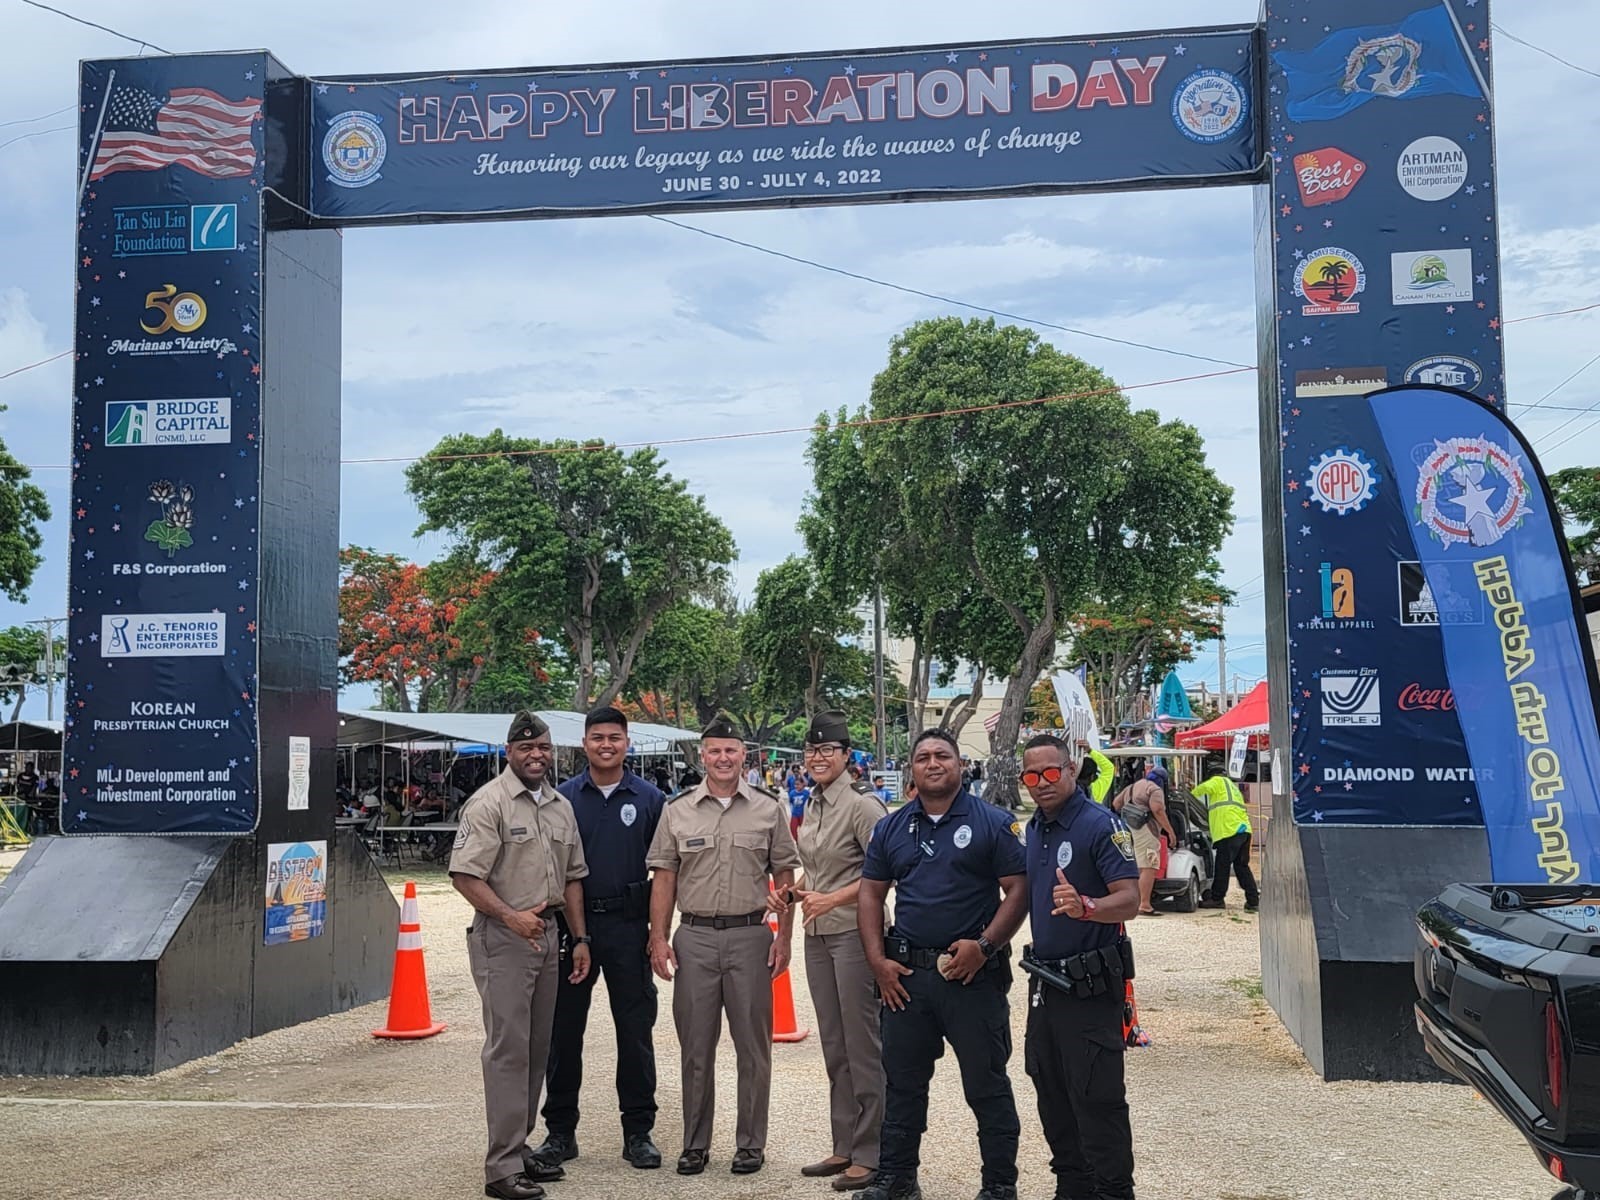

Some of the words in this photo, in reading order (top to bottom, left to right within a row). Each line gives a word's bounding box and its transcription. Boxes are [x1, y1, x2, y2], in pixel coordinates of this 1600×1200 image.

[399, 87, 616, 145] HAPPY
[633, 66, 1011, 135] LIBERATION
[1031, 55, 1167, 112] DAY
[473, 150, 582, 178] Honoring
[589, 150, 630, 170] our
[635, 145, 710, 174] legacy
[718, 147, 744, 163] as
[752, 146, 784, 162] we
[790, 138, 837, 160] ride
[842, 136, 878, 157] the
[883, 137, 955, 155] waves
[964, 128, 990, 157] of
[997, 126, 1082, 156] change
[1402, 151, 1463, 166] ARTMAN
[1299, 160, 1342, 183] Best
[1402, 164, 1464, 176] ENVIRONMENTAL
[662, 176, 712, 193] JUNE
[719, 176, 740, 190] 30
[760, 173, 807, 188] JULY
[814, 171, 831, 187] 4,
[837, 169, 881, 183] 2022
[1305, 169, 1353, 195] Deal
[1417, 176, 1463, 187] Corporation
[114, 213, 138, 230] Tan
[142, 211, 161, 228] Siu
[164, 210, 186, 227] Lin
[114, 231, 186, 251] Foundation
[1293, 259, 1308, 297] PACIFIC
[1306, 246, 1364, 273] AMUSEMENT
[139, 284, 207, 335] 50
[1305, 306, 1331, 315] SAIPAN
[1336, 304, 1357, 313] GUAM
[107, 338, 173, 355] Marianas
[174, 336, 226, 352] Variety
[1434, 373, 1463, 386] CMS
[156, 401, 219, 415] BRIDGE
[155, 416, 229, 431] CAPITAL
[155, 434, 188, 444] (CNMI),
[190, 433, 206, 442] LLC
[1320, 462, 1361, 502] GPPC
[113, 563, 141, 575] F&S
[145, 562, 227, 576] Corporation
[137, 623, 160, 632] J.C.
[164, 622, 218, 631] TENORIO
[1306, 621, 1336, 630] ISLAND
[1339, 620, 1375, 629] APPAREL
[136, 632, 218, 642] ENTERPRISES
[136, 642, 218, 650] INCORPORATED
[1360, 667, 1378, 676] First
[130, 701, 196, 716] KOREAN
[179, 718, 229, 729] CHURCH
[1324, 716, 1368, 724] TRIPLE
[1371, 715, 1380, 724] J
[97, 769, 122, 783] MLJ
[126, 768, 205, 784] Development
[207, 768, 230, 782] and
[1324, 767, 1415, 782] DIAMOND
[1425, 767, 1496, 782] WATER
[97, 788, 164, 803] Investment
[166, 787, 236, 804] Corporation
[268, 857, 314, 883] BISTRO
